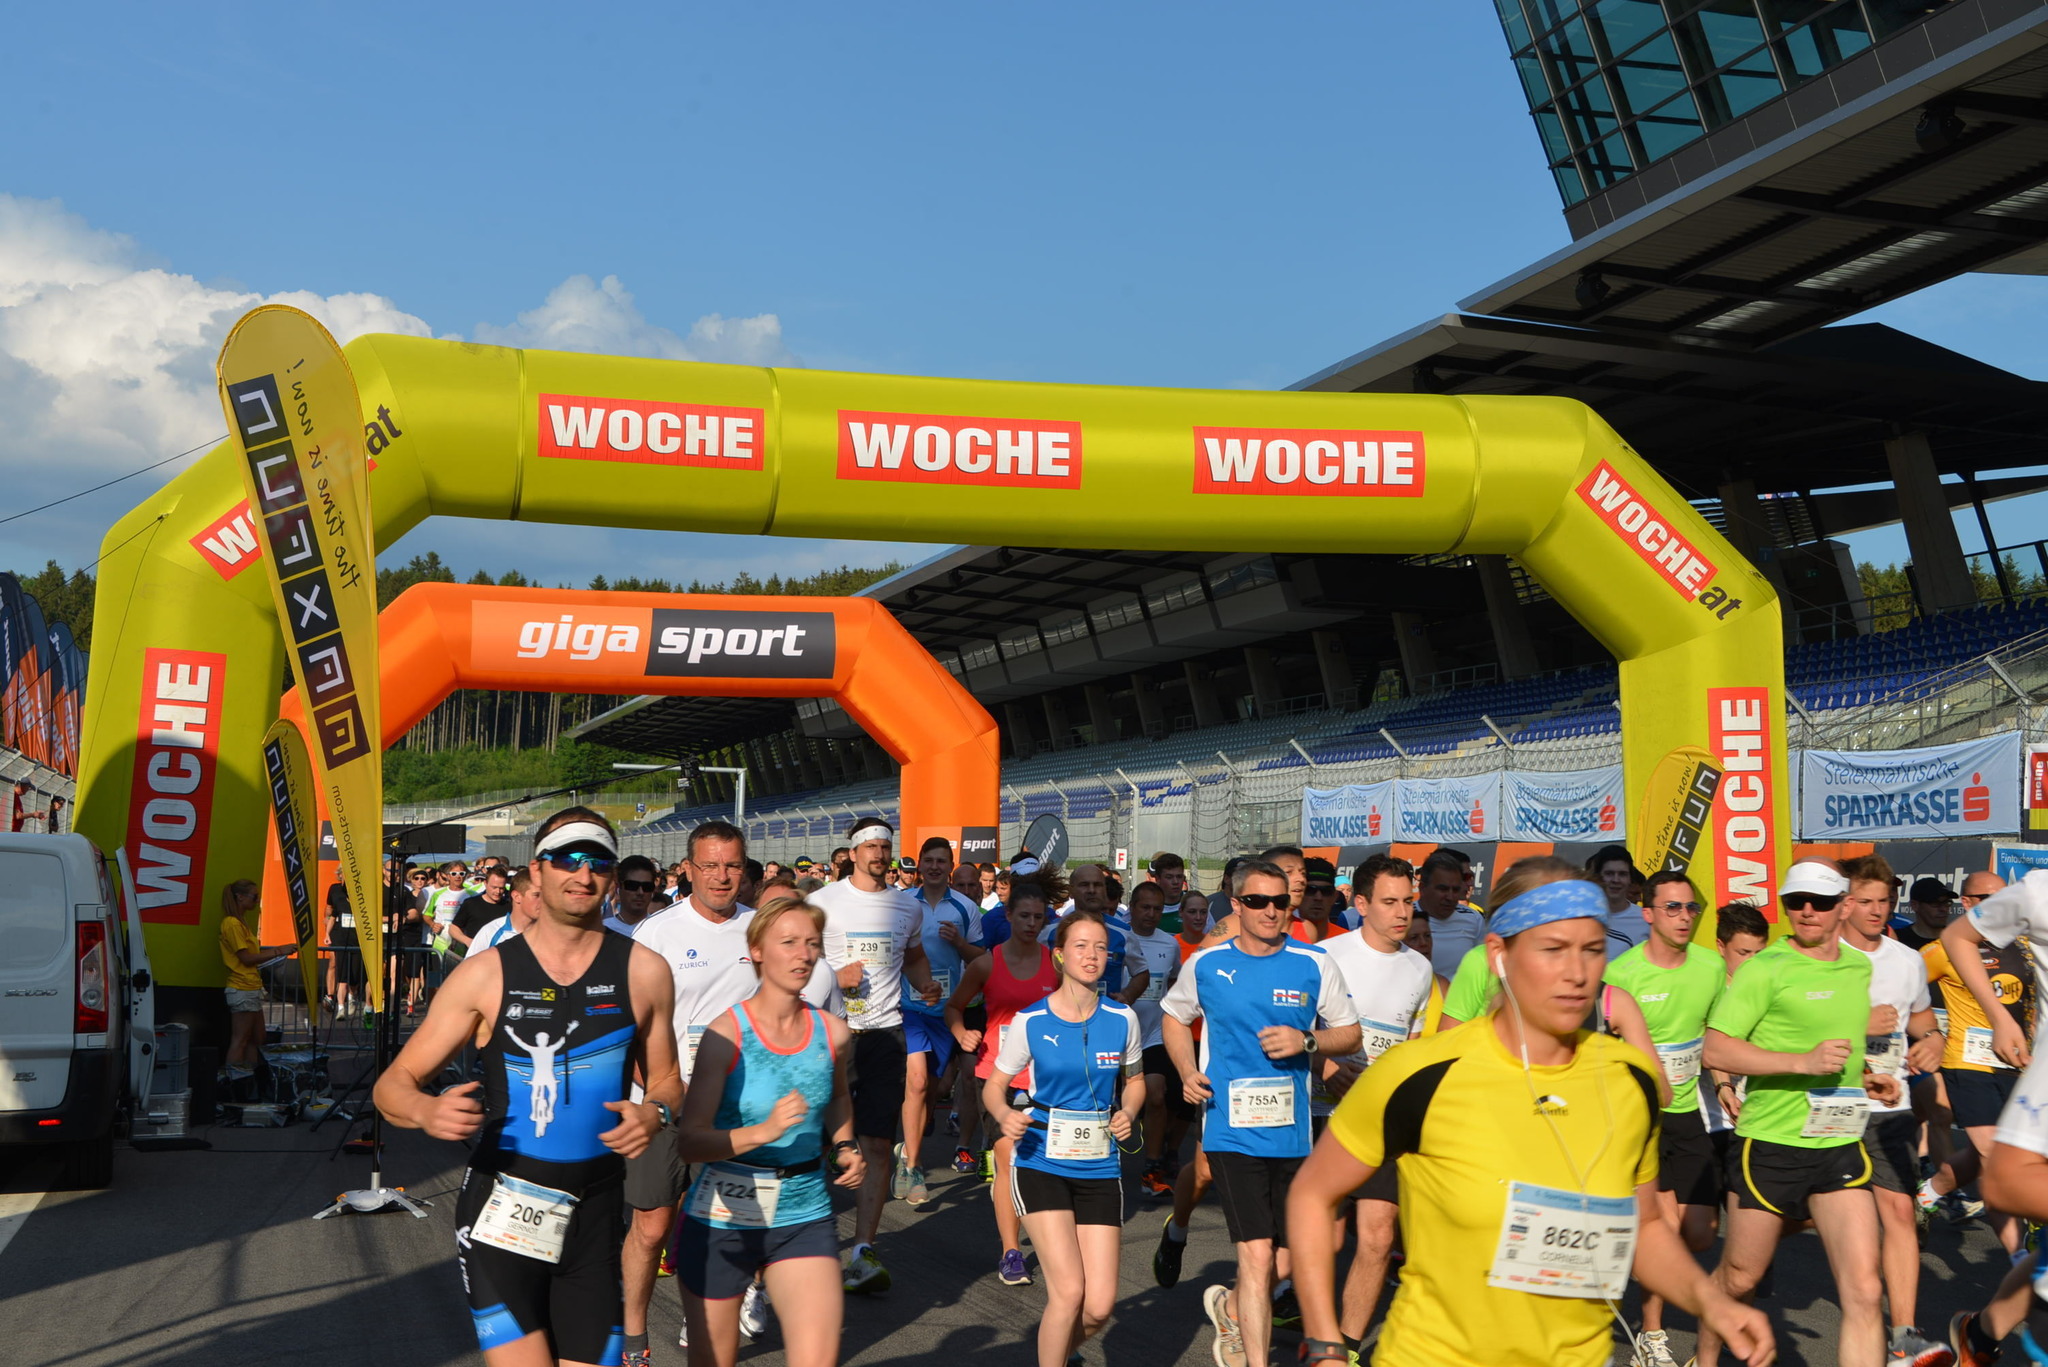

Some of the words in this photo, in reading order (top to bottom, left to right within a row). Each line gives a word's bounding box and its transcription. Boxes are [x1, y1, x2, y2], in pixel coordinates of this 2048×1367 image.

[548, 404, 753, 459] WOCHE
[848, 421, 1070, 477] WOCHE
[1203, 437, 1414, 485] WOCHE
[517, 615, 640, 661] giga
[658, 624, 806, 664] sport
[1824, 757, 1960, 786] Steiermärkische
[2034, 760, 2044, 801] meine
[136, 662, 211, 910] WOCHE
[1720, 699, 1769, 907] WOCHE
[1824, 788, 1960, 828] SPARKASSE
[1309, 815, 1368, 838] SPARKASSE
[1401, 810, 1470, 835] SPARKASSE
[1515, 807, 1599, 835] SPARKASSE
[962, 838, 997, 852] sport
[1117, 852, 1125, 866] F
[860, 942, 879, 952] 239
[679, 960, 708, 970] ZURICH
[1641, 992, 1669, 1003] SKF
[1371, 1035, 1392, 1050] 238
[1247, 1095, 1279, 1106] 755A
[1073, 1127, 1091, 1140] 96
[509, 1203, 546, 1226] 206
[507, 1221, 540, 1235] GERNOT
[1543, 1226, 1601, 1251] 862C
